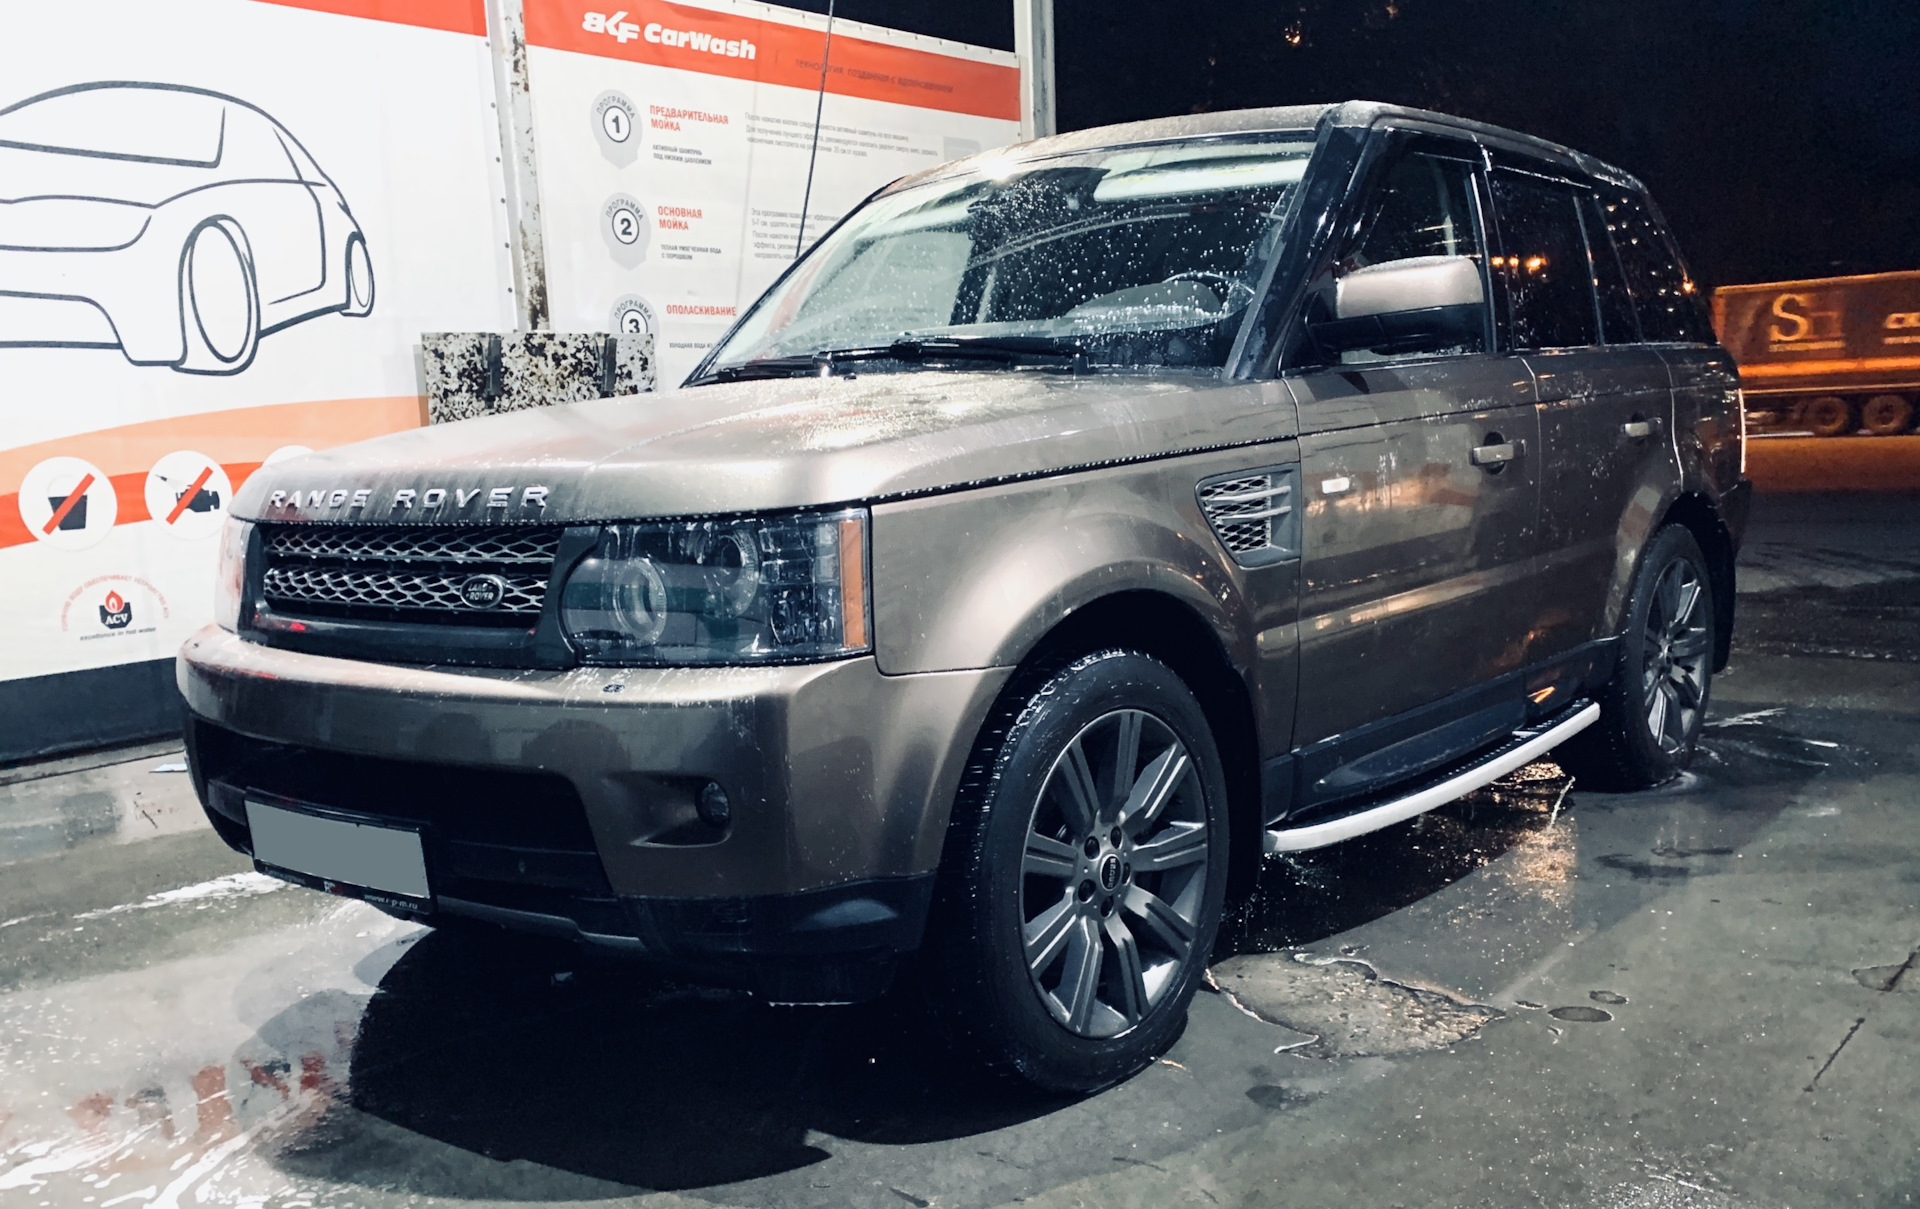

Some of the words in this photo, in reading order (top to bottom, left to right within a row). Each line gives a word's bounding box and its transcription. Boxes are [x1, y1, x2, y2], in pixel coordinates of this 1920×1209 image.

[644, 23, 756, 60] CarWash
[597, 96, 635, 118] ПРОГРАММА
[650, 105, 729, 124] ПРЕДВАРИТЕЛЬНАЯ
[612, 115, 620, 133] 1
[651, 118, 681, 131] МОЙКА
[606, 199, 644, 220] ПРОГРАММА
[658, 206, 702, 218] ОСНОВНАЯ
[620, 218, 632, 235] 2
[659, 218, 689, 230] МОЙКА
[614, 300, 652, 320] ПРОГРАММА
[666, 304, 737, 317] ОПОЛАСКИВАНИЕ
[628, 318, 640, 333] 3
[269, 488, 372, 509] RANGE
[392, 486, 549, 508] ROVER
[469, 592, 494, 601] ROVER
[105, 613, 128, 625] ACV
